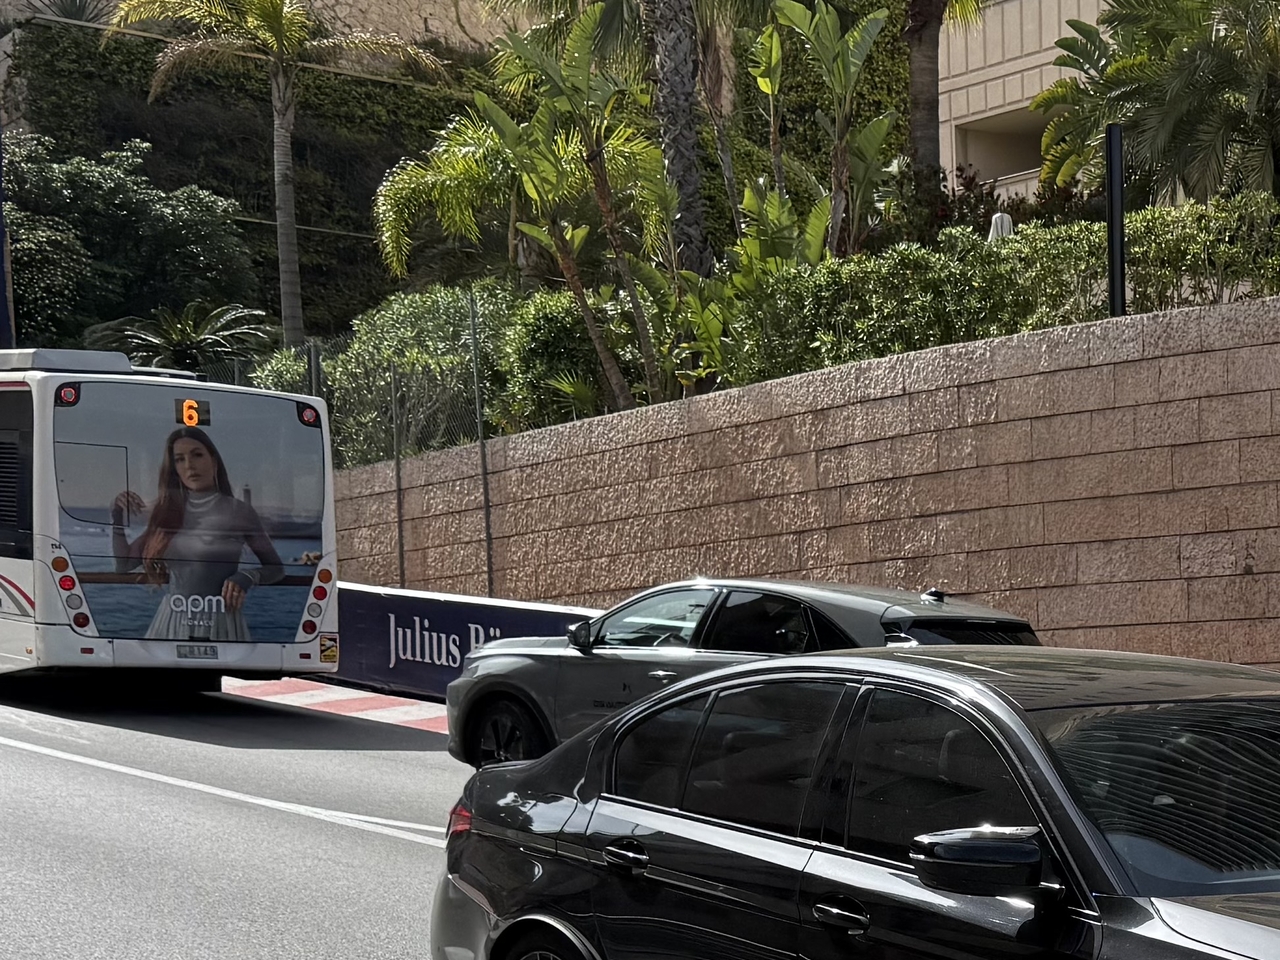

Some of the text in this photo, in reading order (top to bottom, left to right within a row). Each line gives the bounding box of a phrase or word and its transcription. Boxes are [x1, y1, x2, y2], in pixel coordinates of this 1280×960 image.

[182, 399, 199, 426] 6
[170, 594, 226, 618] apm
[387, 613, 462, 669] Julius
